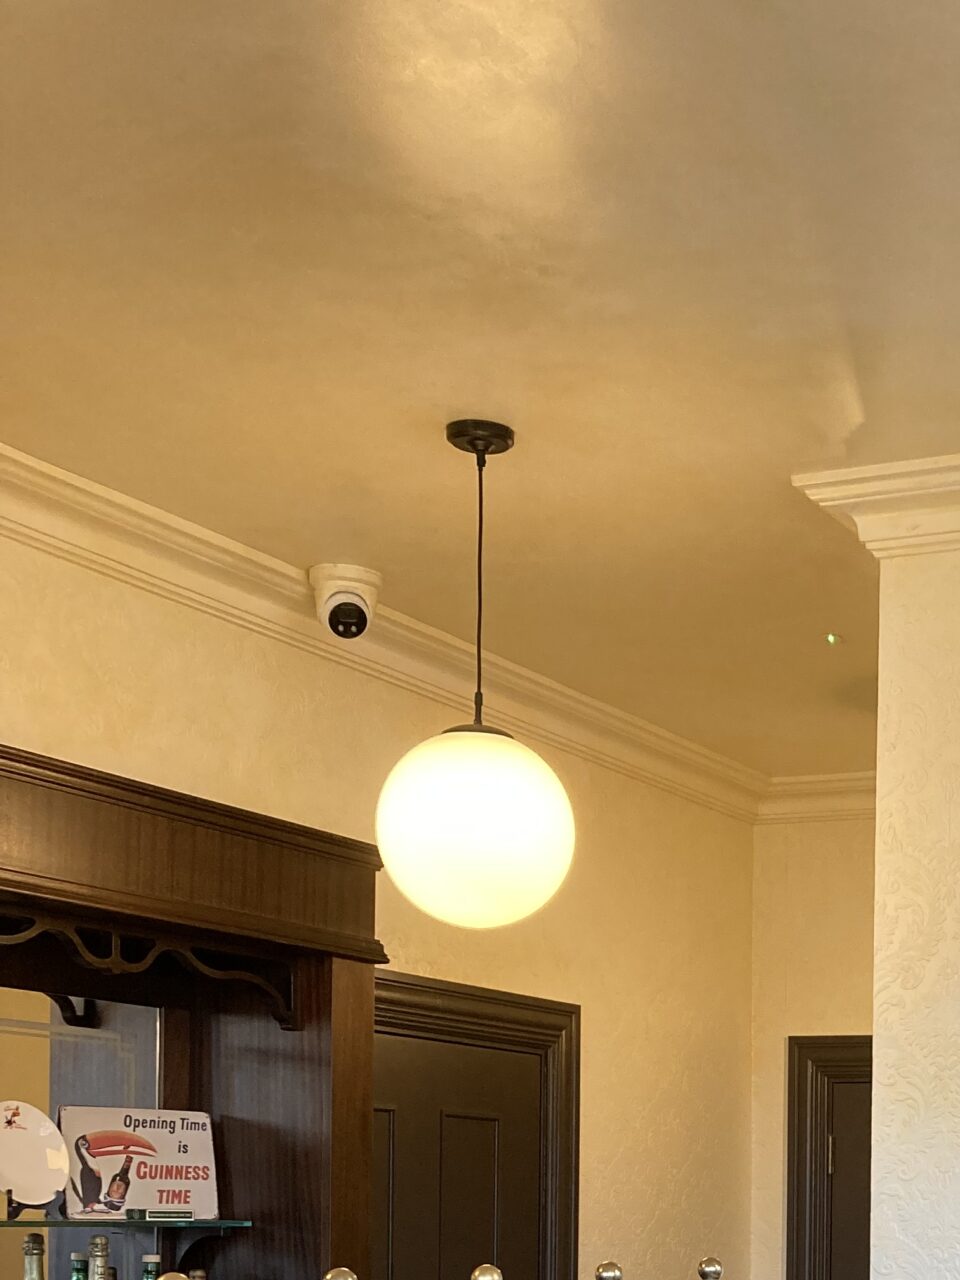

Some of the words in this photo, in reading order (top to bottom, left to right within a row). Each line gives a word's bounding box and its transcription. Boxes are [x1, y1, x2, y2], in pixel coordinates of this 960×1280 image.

[123, 1114, 176, 1134] Opening
[180, 1117, 207, 1131] Time
[178, 1141, 189, 1154] is
[136, 1161, 210, 1181] GUINNESS
[157, 1189, 191, 1205] TIME
